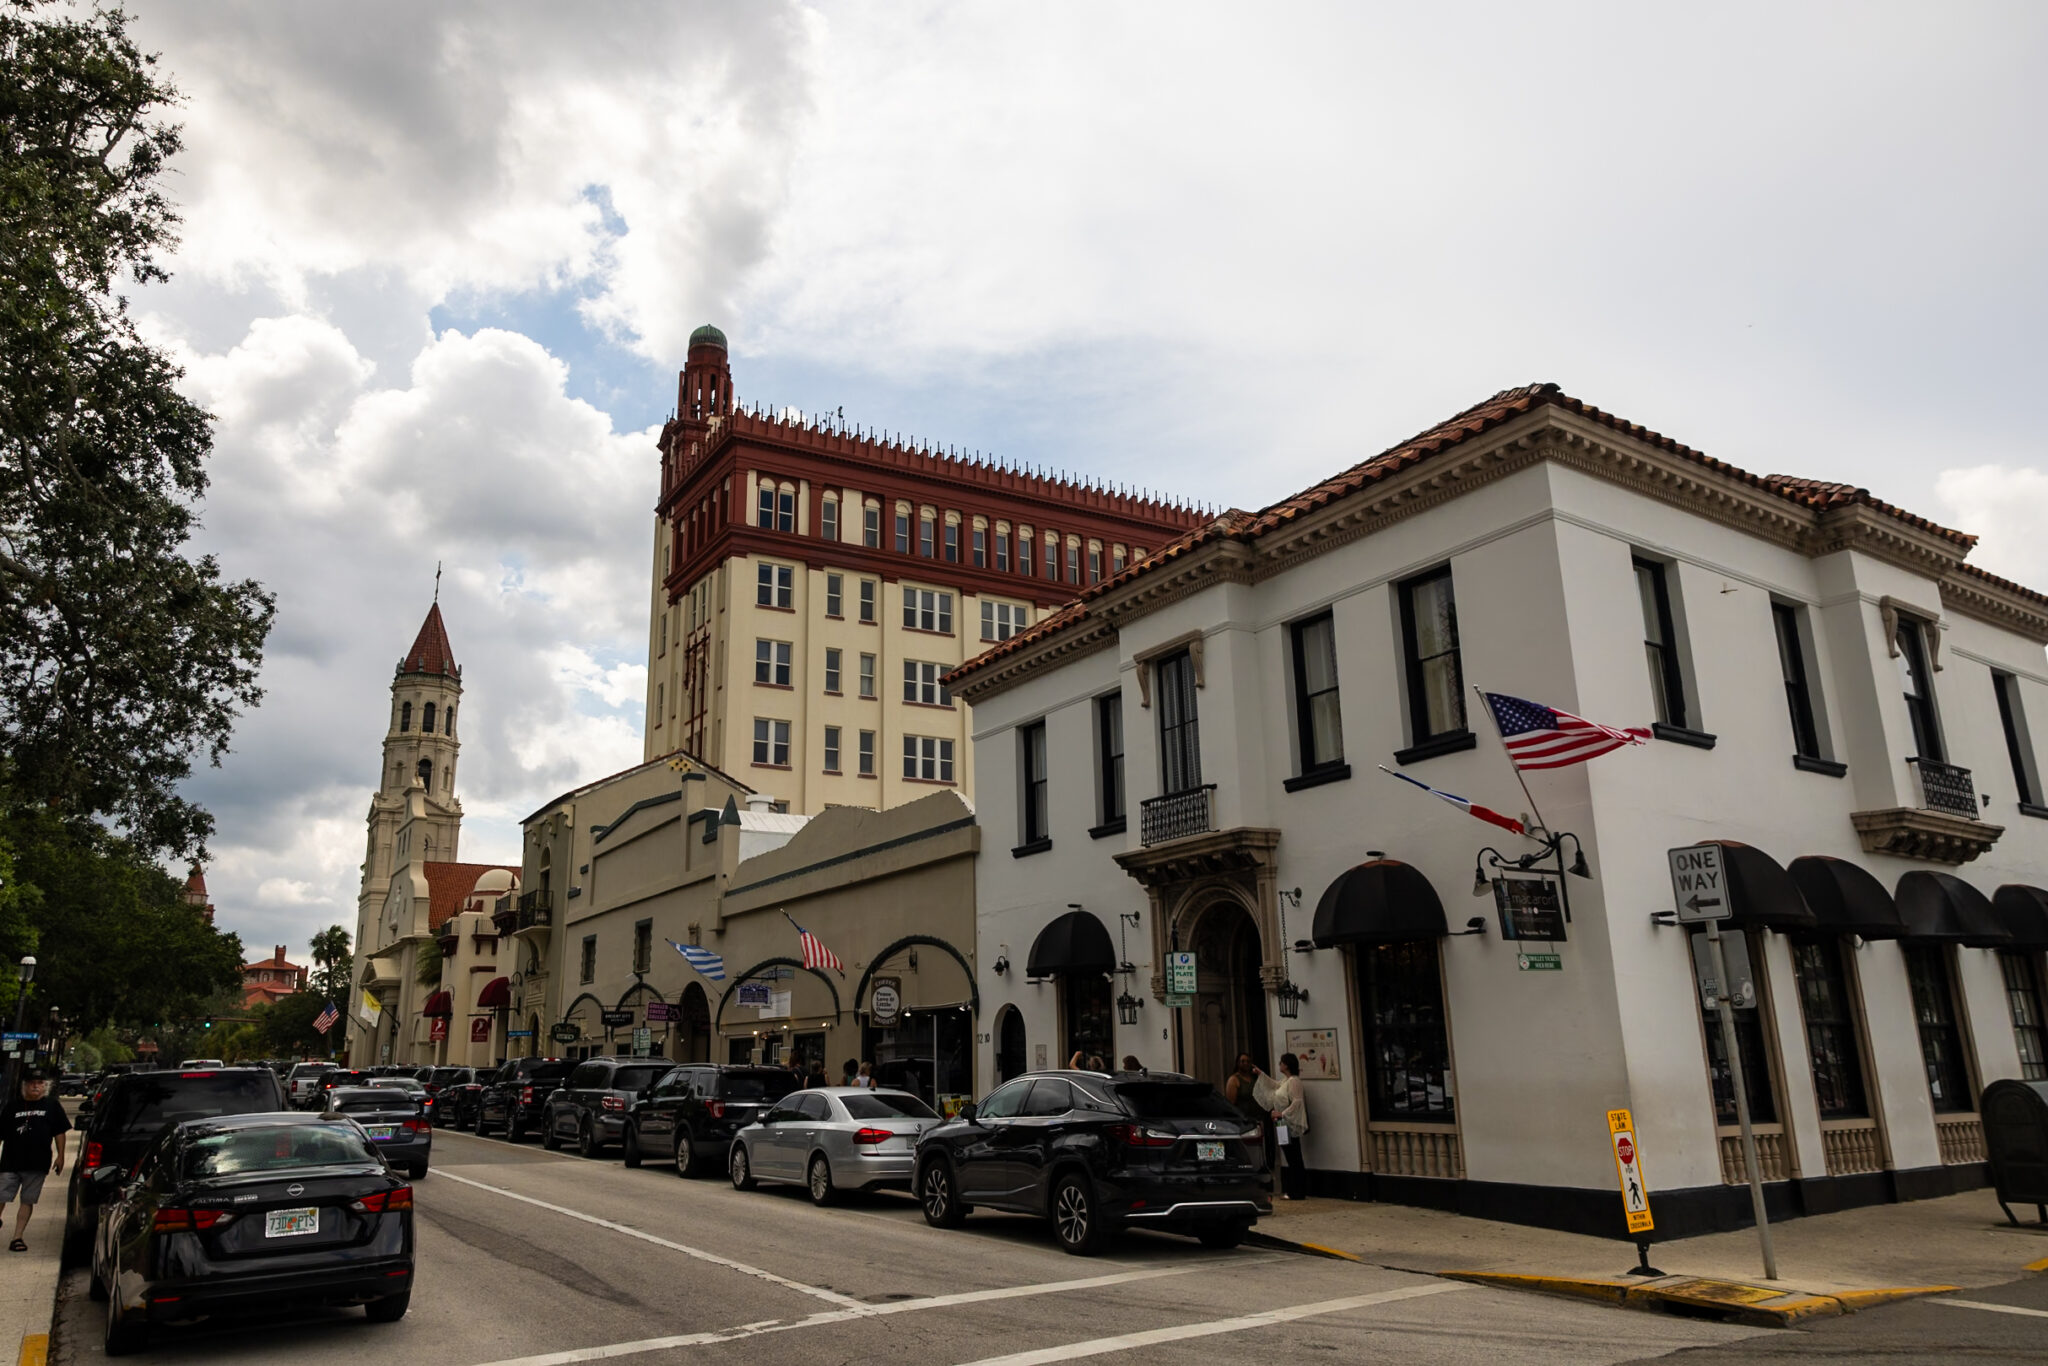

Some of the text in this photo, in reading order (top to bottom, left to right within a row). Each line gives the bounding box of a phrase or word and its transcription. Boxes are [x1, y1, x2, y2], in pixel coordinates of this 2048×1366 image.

[1676, 851, 1716, 871] ONE
[1678, 871, 1719, 892] WAY
[1163, 1028, 1168, 1040] 8
[1610, 1112, 1627, 1121] STATE
[1615, 1122, 1626, 1130] LAW
[1618, 1145, 1633, 1157] STOP
[297, 1214, 316, 1228] PTS
